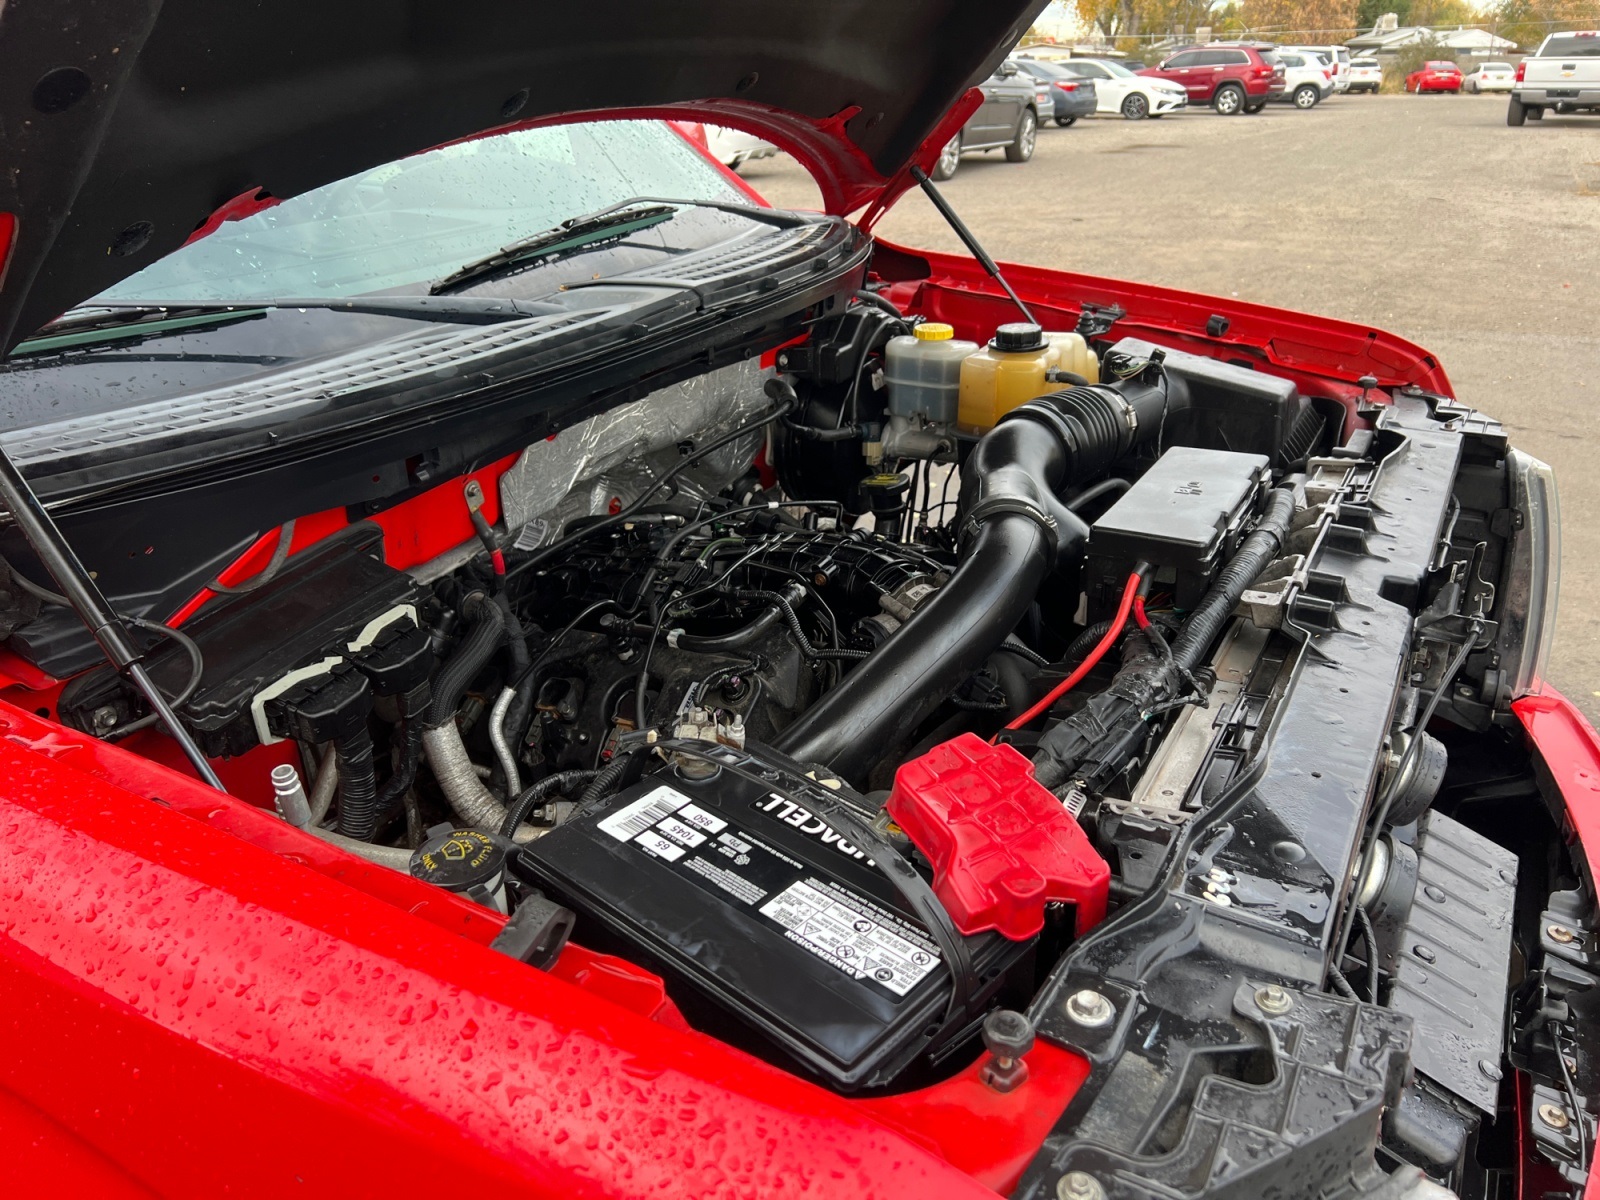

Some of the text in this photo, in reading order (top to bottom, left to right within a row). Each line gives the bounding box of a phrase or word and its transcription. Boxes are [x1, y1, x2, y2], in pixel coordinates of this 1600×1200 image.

[693, 814, 713, 826] 850
[670, 825, 695, 841] 1045
[763, 793, 876, 867] RACELL
[423, 831, 493, 870] WASHER FLUID ONLY
[654, 840, 670, 851] 65
[729, 838, 742, 848] Pb
[782, 929, 857, 974] DANGER/POISON
